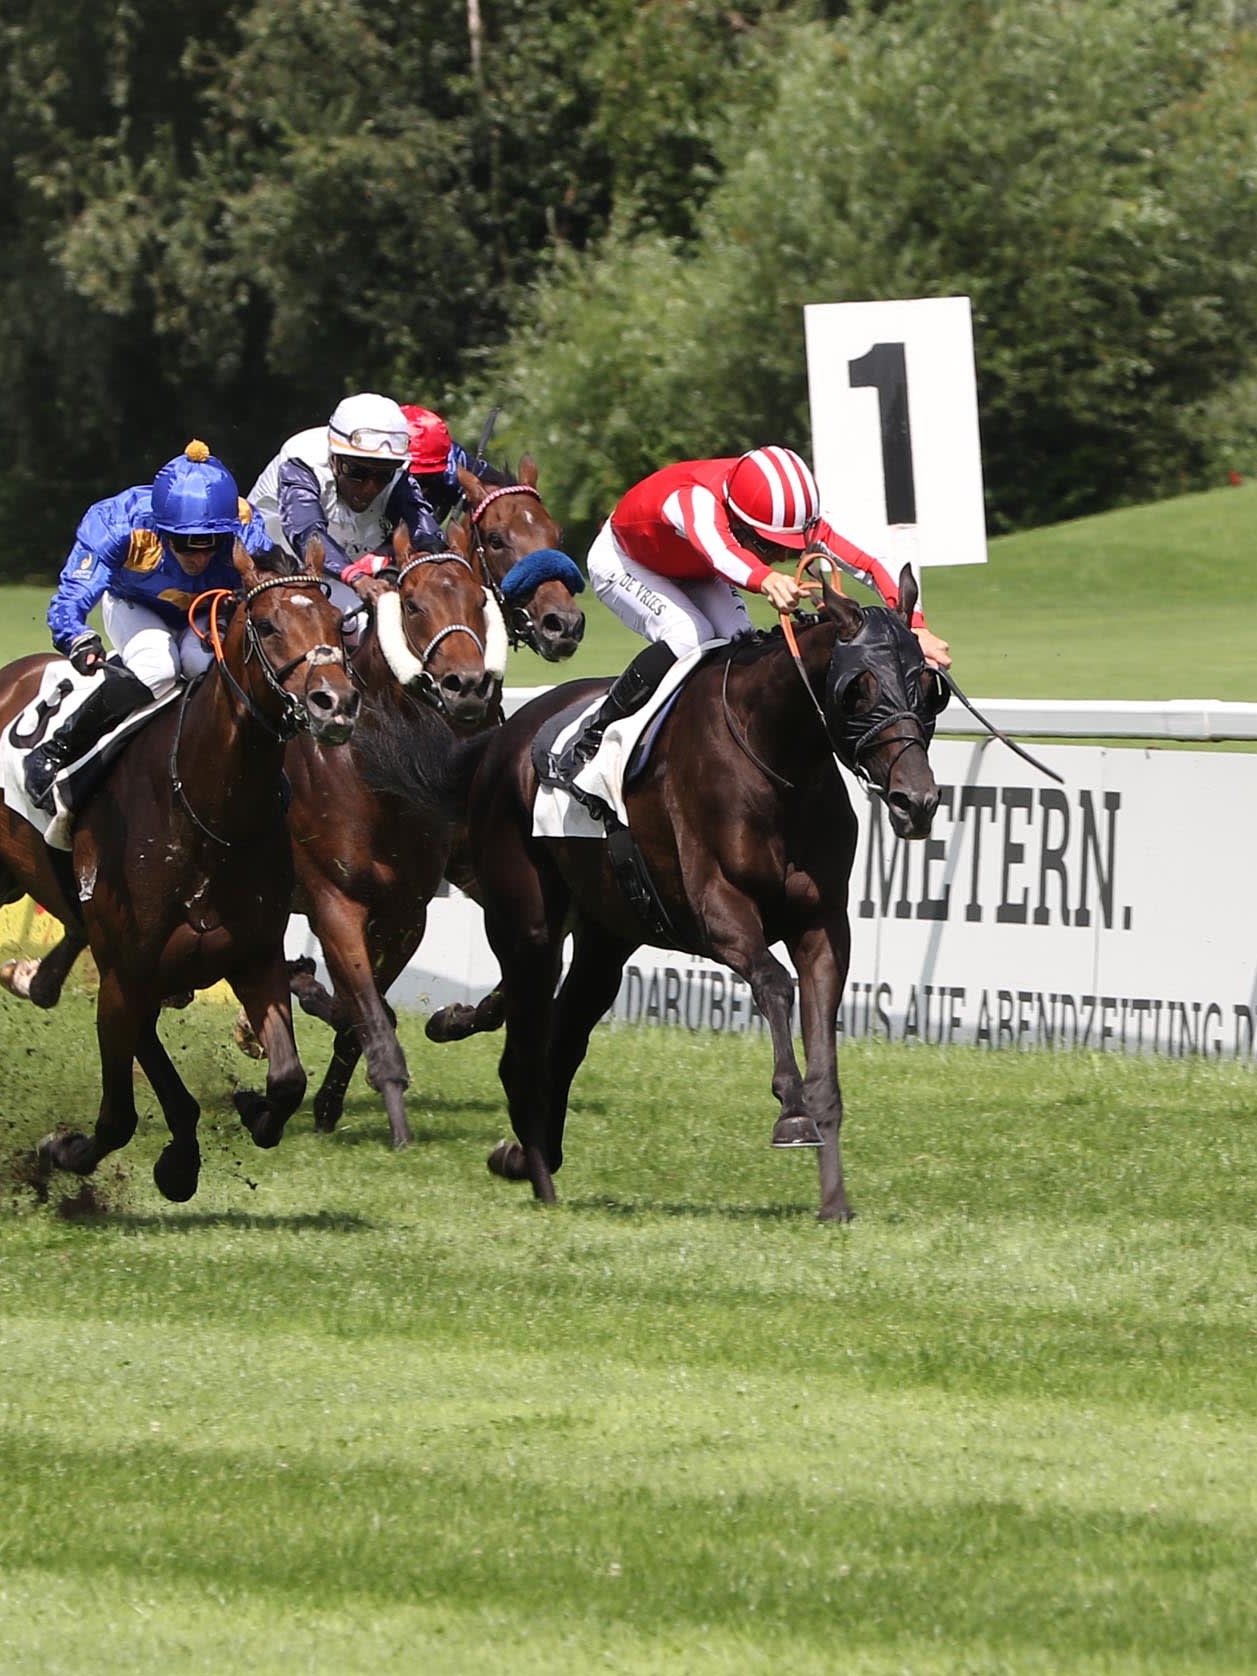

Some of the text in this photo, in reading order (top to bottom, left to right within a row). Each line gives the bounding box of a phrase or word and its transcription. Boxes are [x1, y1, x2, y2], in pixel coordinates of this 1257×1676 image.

[848, 342, 917, 525] 1
[618, 572, 638, 593] DE
[634, 582, 667, 616] VRIES
[8, 678, 74, 749] 3
[859, 784, 1132, 930] METERN.
